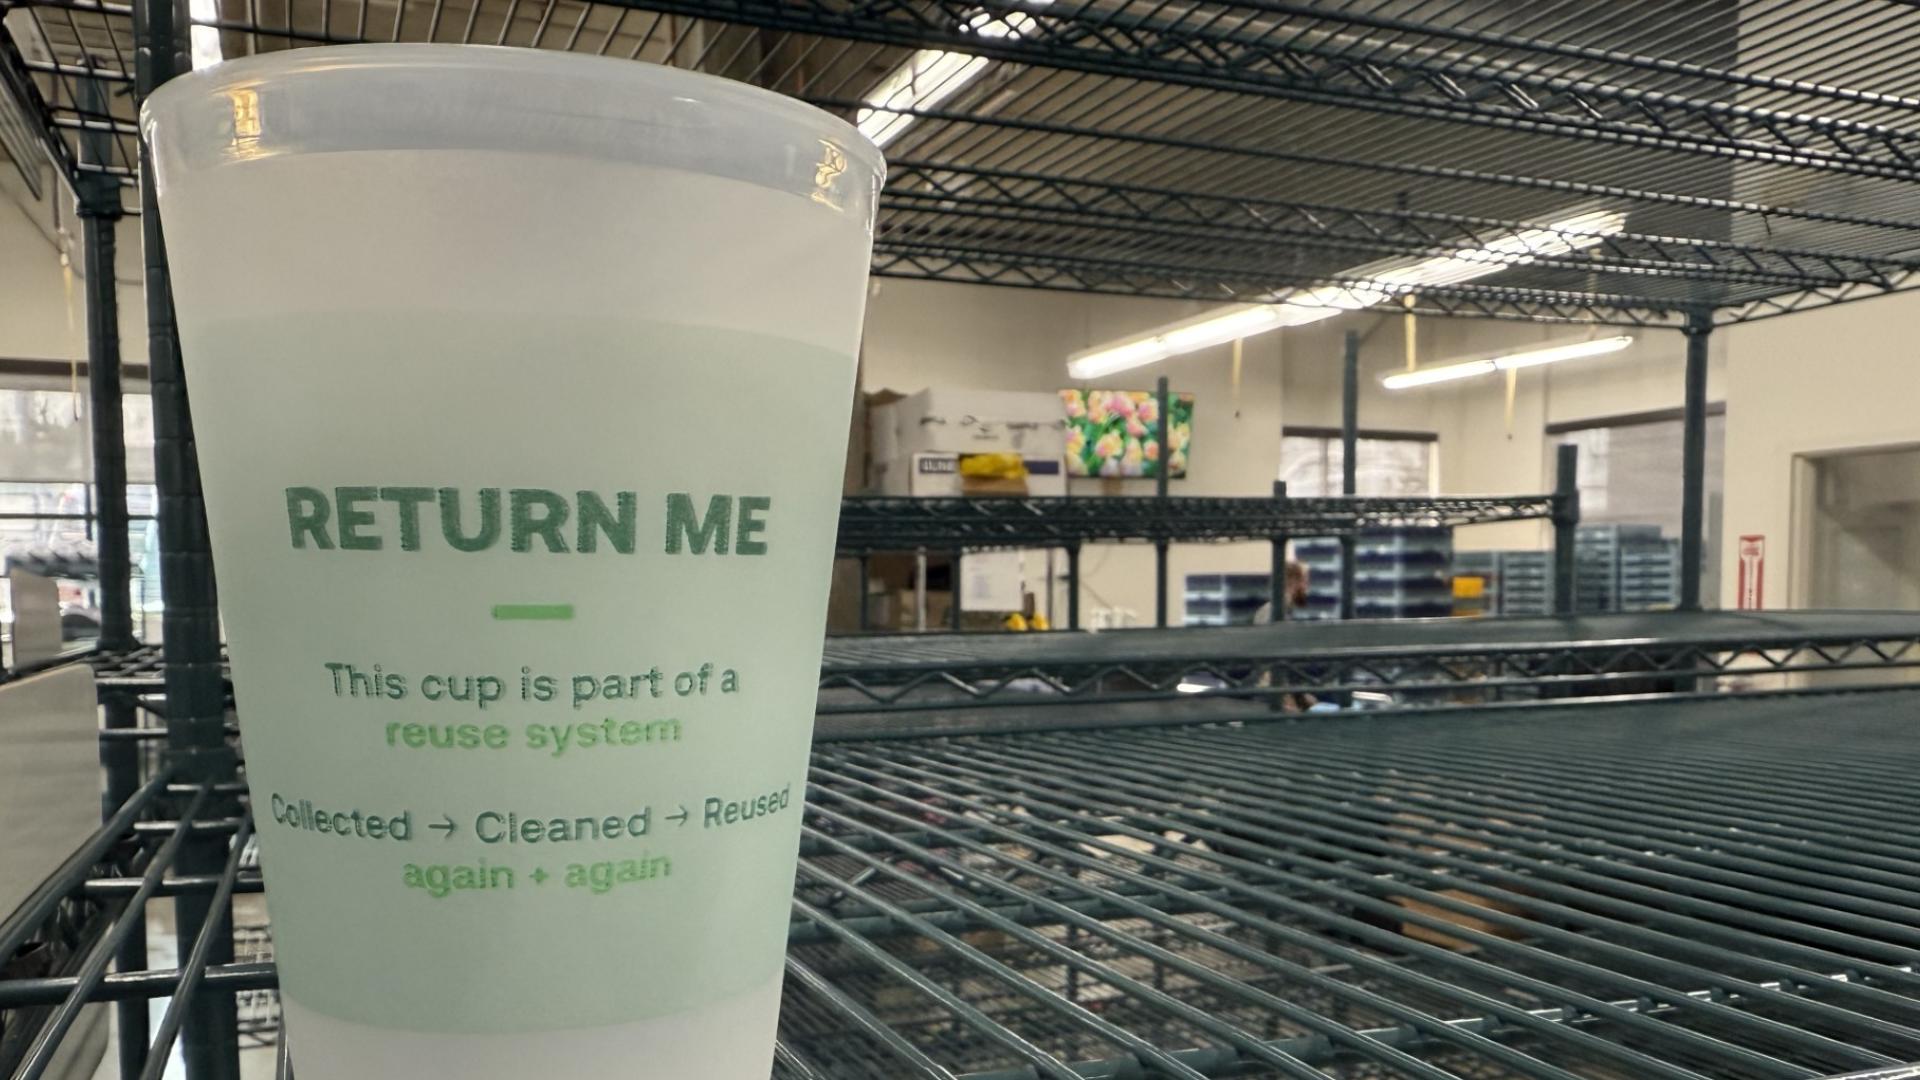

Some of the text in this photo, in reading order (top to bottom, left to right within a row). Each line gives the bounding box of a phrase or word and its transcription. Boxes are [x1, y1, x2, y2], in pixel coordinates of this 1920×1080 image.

[285, 486, 771, 556] RETURN ME
[324, 662, 739, 710] This cup is part of a
[385, 718, 683, 758] reuse system
[271, 782, 791, 844] Collected Cleaned Reused
[402, 857, 514, 898] again
[564, 853, 672, 895] again
